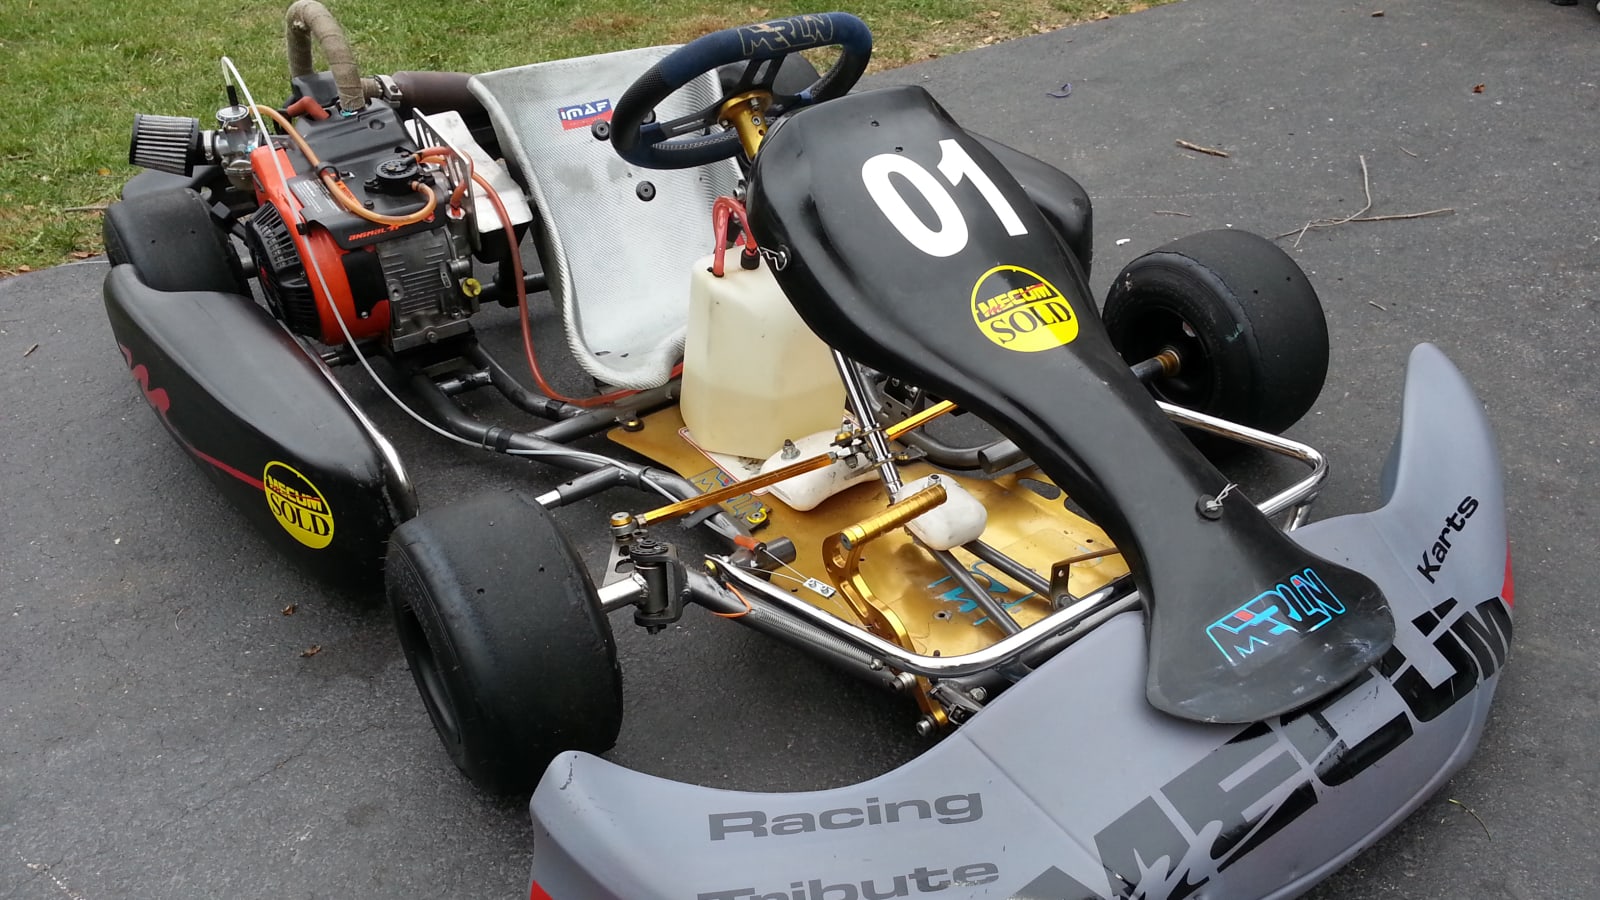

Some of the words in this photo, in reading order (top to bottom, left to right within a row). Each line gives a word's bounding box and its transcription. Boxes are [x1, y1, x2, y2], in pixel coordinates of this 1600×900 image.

[737, 14, 834, 56] MERLIN
[560, 102, 608, 120] IMAF
[861, 138, 1029, 258] 01
[977, 284, 1052, 318] MECUM
[990, 301, 1071, 344] SOLD
[267, 474, 323, 511] MECUM
[270, 493, 330, 536] SOLD
[1416, 495, 1479, 585] Karts
[1206, 568, 1346, 666] MERLIN
[708, 793, 984, 841] Racing
[697, 863, 1000, 900] ibute
